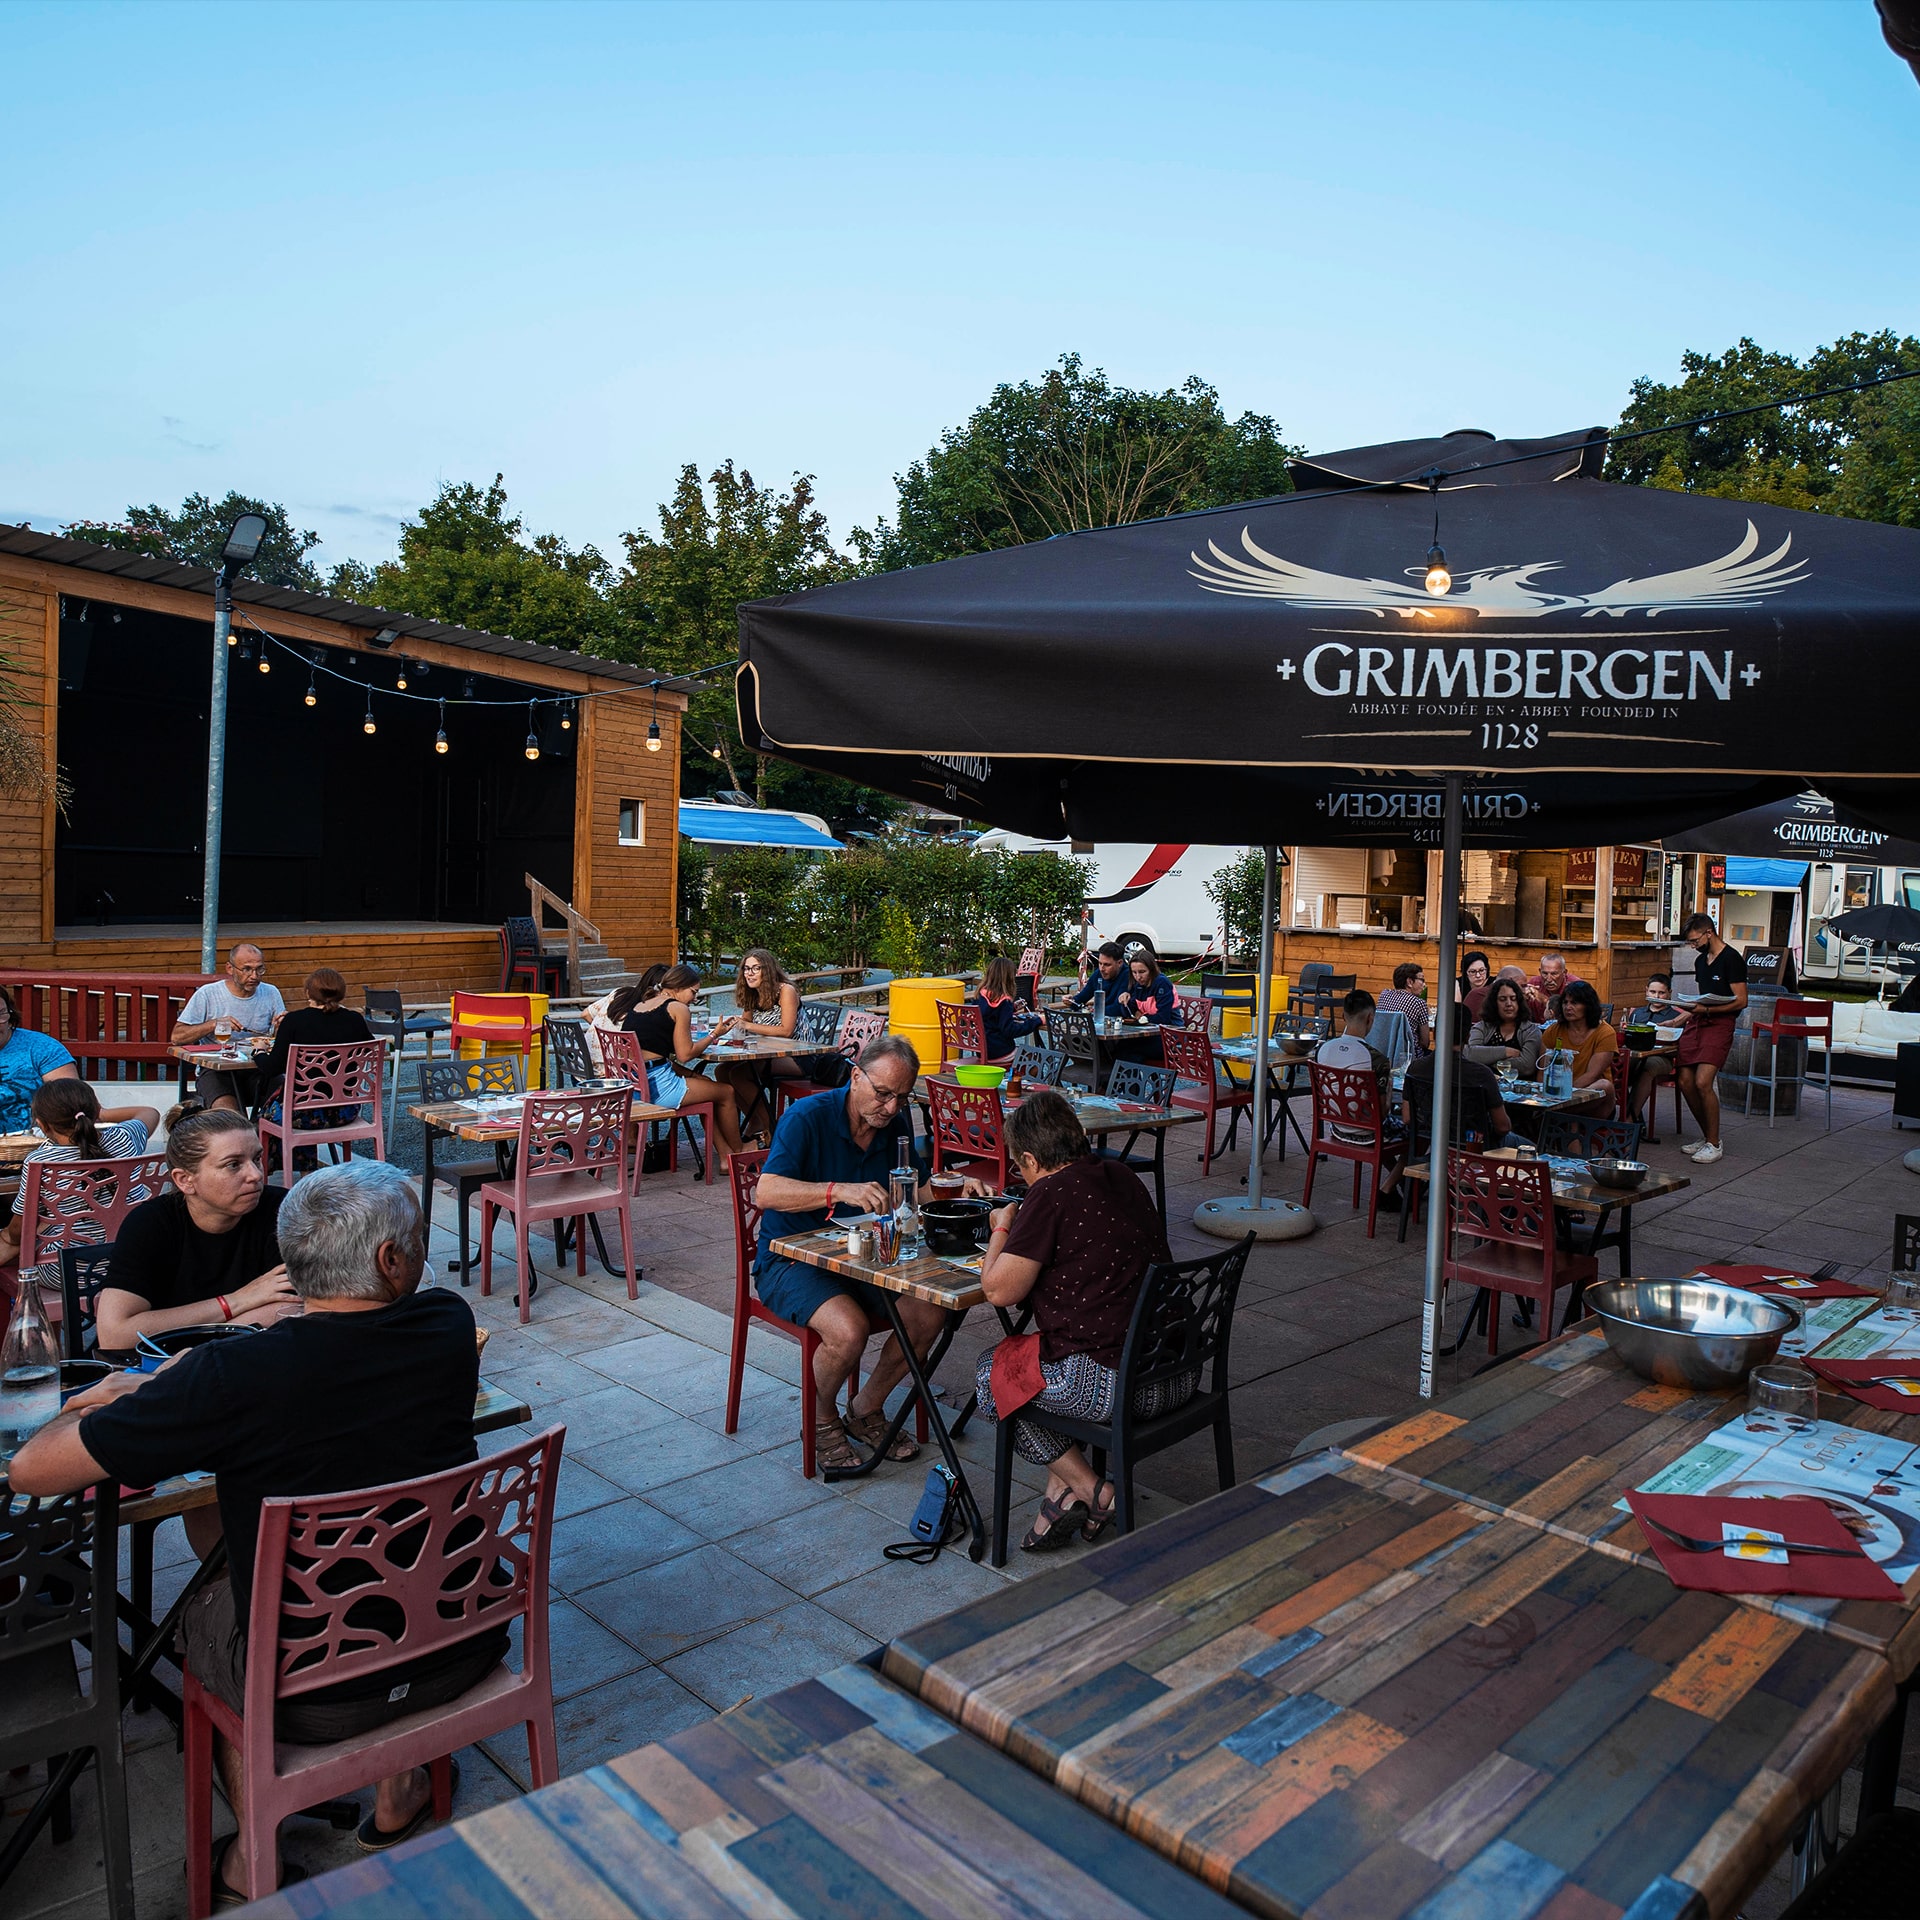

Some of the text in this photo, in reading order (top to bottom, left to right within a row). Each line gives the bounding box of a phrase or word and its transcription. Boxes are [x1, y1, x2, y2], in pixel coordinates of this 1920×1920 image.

[1302, 642, 1734, 700] GRIMBERGEN
[1348, 701, 1680, 718] ABBAYE FONDÉE EN ABBEY FOUNDED IN
[1480, 722, 1540, 750] 1128
[1778, 822, 1882, 845] GRIMBERGEN
[1570, 850, 1641, 867] KITEN
